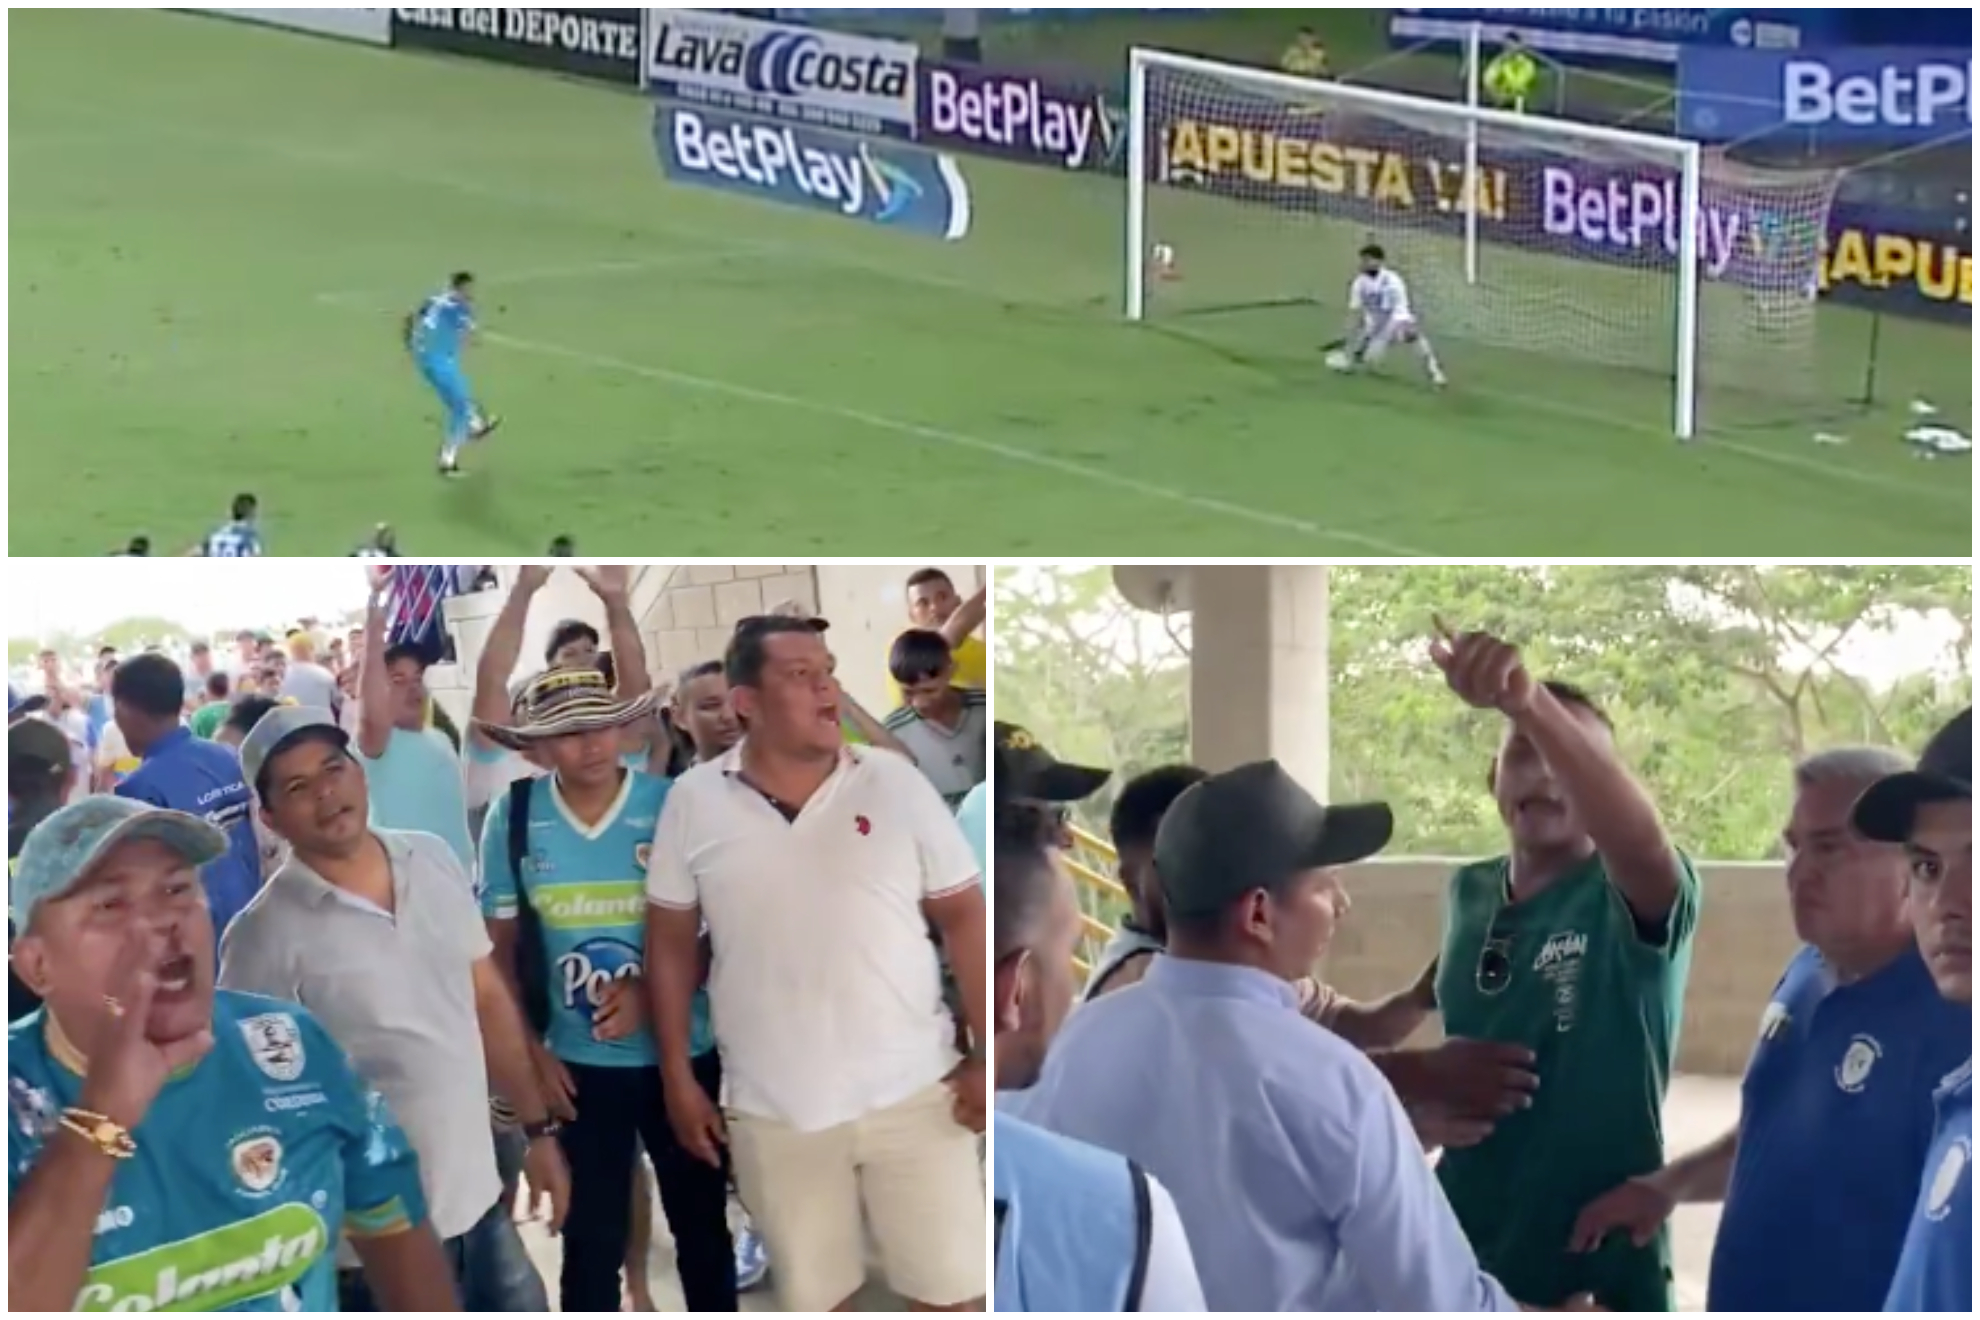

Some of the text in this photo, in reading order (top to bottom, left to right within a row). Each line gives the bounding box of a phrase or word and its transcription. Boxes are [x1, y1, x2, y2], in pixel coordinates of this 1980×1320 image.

[505, 9, 636, 58] DEPORTE
[654, 23, 743, 77] Lava
[931, 70, 1093, 168] BetPlay
[674, 110, 865, 214] BetPlay
